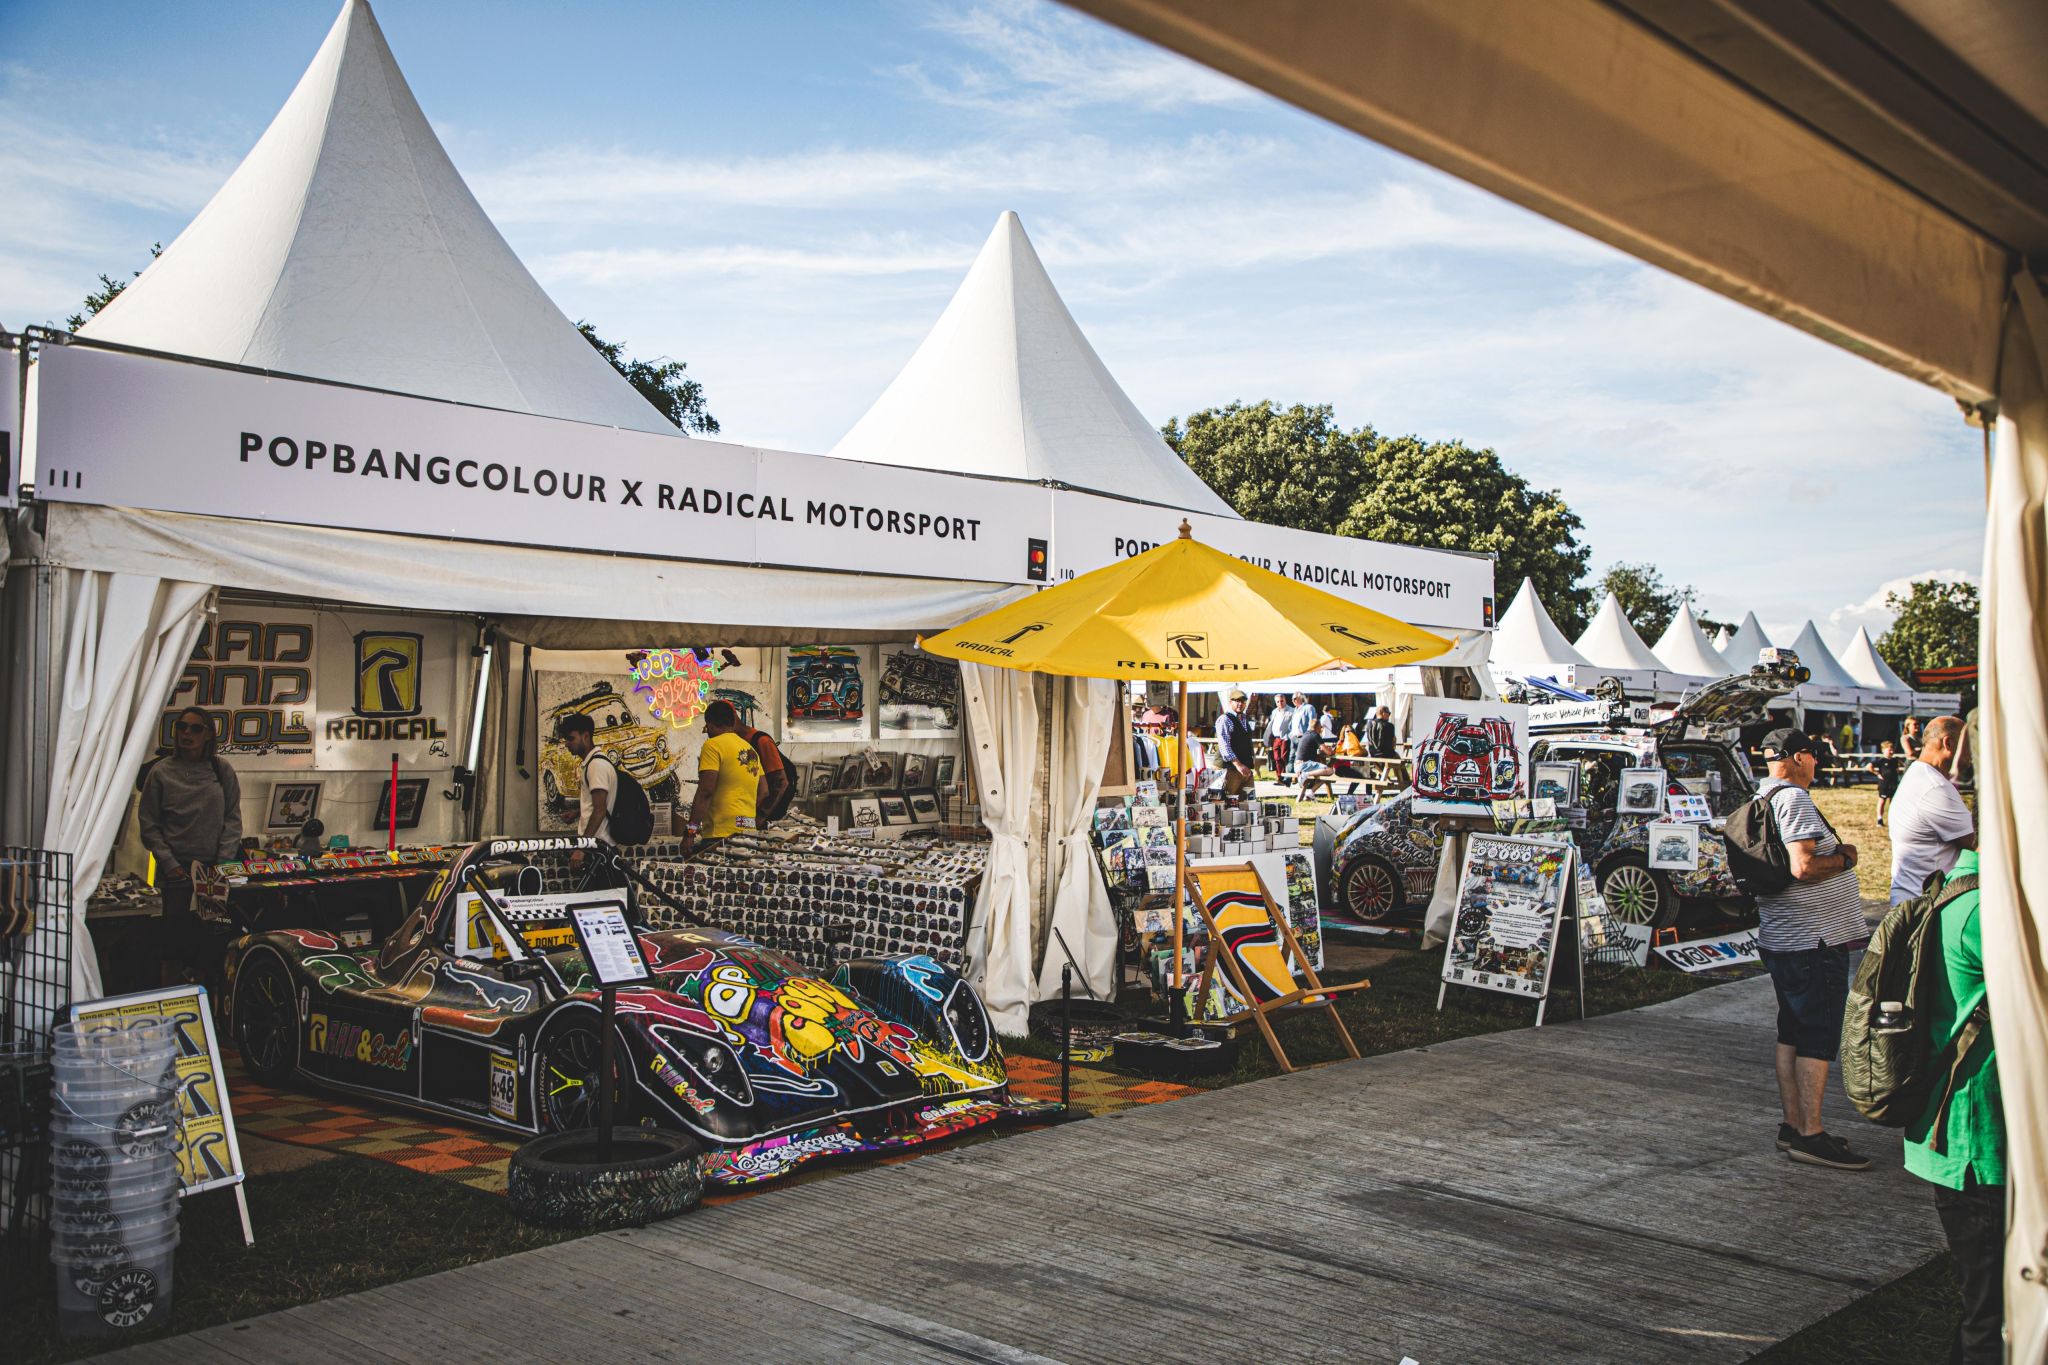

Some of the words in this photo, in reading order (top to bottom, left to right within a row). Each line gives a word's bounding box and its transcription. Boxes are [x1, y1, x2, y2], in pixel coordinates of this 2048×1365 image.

[239, 431, 607, 503] POPBANGCOLOUR
[620, 478, 643, 507] X
[657, 484, 794, 522] RADICAL
[806, 500, 981, 541] MOTORSPORT
[1293, 563, 1358, 588] RADICAL
[1363, 572, 1451, 599] MOTORSPORT
[955, 640, 1015, 658] RADICAL
[1358, 645, 1419, 659] RADICAL
[1117, 660, 1260, 671] RADICAL
[821, 679, 832, 693] 12
[325, 717, 447, 740] RADICAL
[490, 837, 598, 855] @RADICAL.UK
[536, 935, 560, 947] DONT
[491, 1072, 515, 1104] 6:48
[738, 1132, 847, 1170] @POPBANGCOLOUR
[101, 1272, 155, 1305] CHEMICAL
[112, 1306, 149, 1326] GUYS
